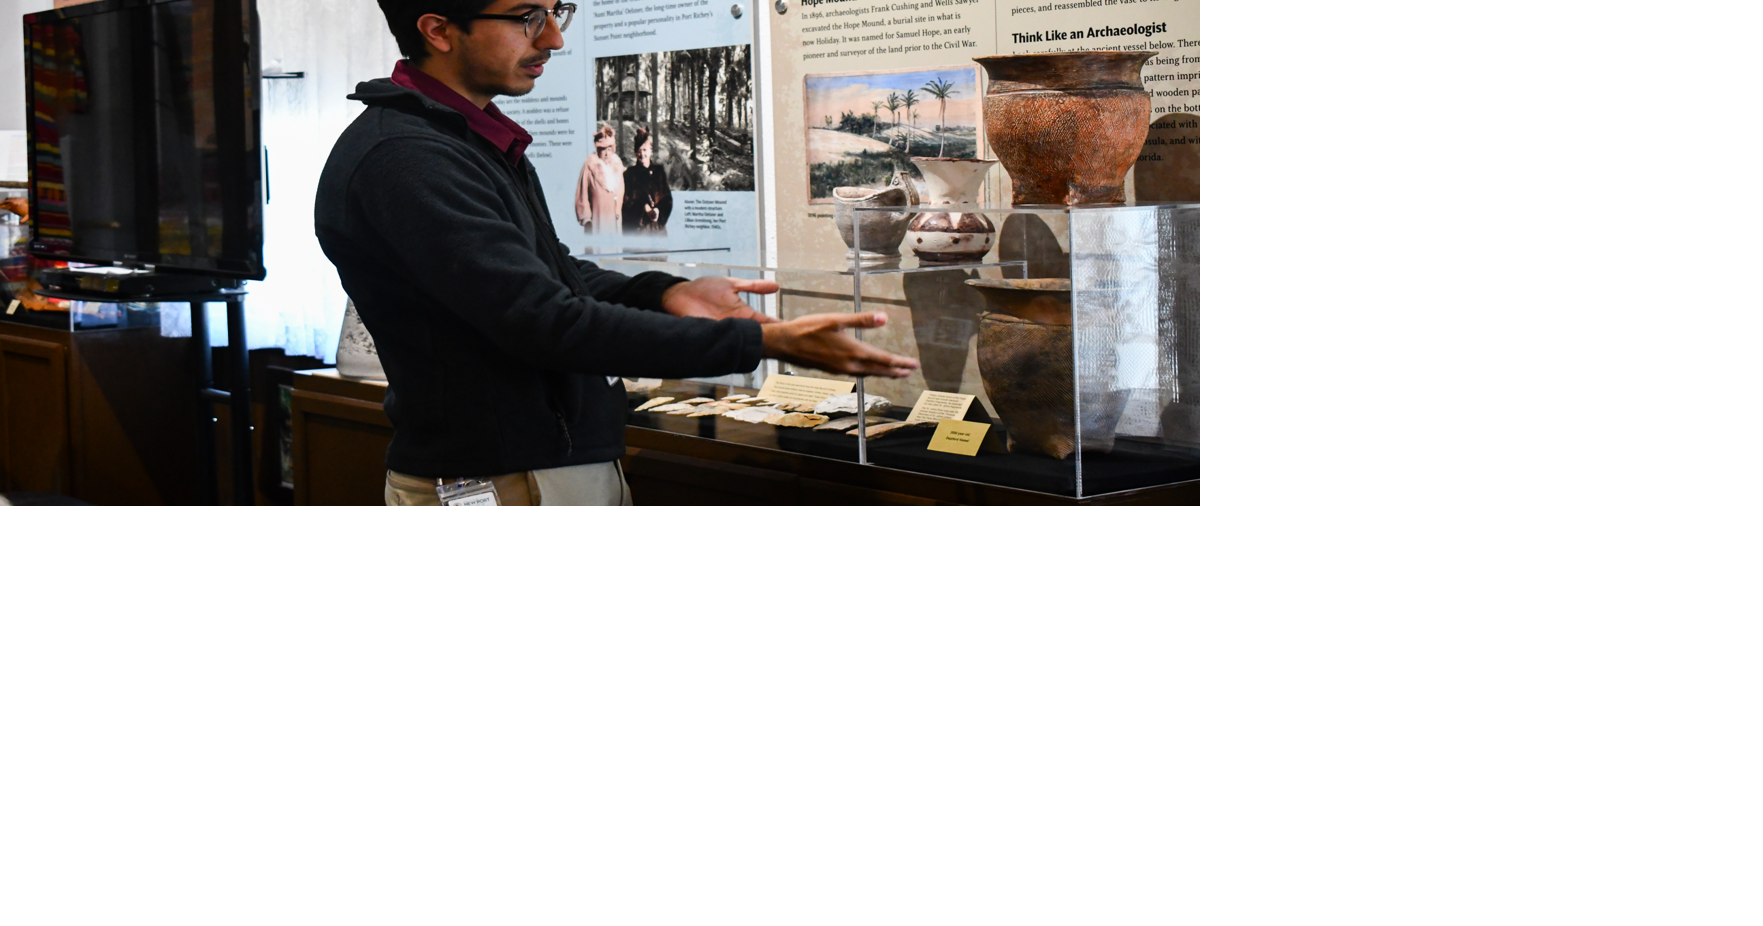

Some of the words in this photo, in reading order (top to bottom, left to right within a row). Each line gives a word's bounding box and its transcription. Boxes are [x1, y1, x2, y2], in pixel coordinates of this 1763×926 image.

[654, 3, 676, 12] long-time
[809, 11, 824, 20] 1896,
[826, 7, 869, 17] archaeologists
[871, 4, 890, 13] Frank
[891, 3, 919, 11] Cushing
[1011, 6, 1036, 16] pieces,
[1038, 3, 1052, 12] and
[1054, 0, 1102, 10] reassembled
[594, 23, 613, 31] property
[628, 19, 647, 28] popular
[648, 15, 674, 25] personality
[802, 24, 830, 33] excavated
[844, 22, 860, 30] Hope
[861, 19, 886, 27] Mound,
[893, 16, 913, 25] burial
[928, 14, 935, 22] in
[936, 13, 953, 21] what
[623, 29, 656, 39] neighborhood.
[816, 36, 840, 45] Holiday.
[861, 32, 883, 41] named
[896, 29, 920, 39] Samuel
[922, 29, 942, 38] Hope,
[954, 25, 971, 35] early
[1012, 31, 1043, 43] Think
[1045, 30, 1067, 41] Like
[1070, 30, 1084, 39] an
[1086, 22, 1167, 38] Archaeologist
[803, 52, 825, 61] pioneer
[840, 49, 867, 57] surveyor
[868, 47, 875, 55] of
[876, 46, 886, 54] the
[888, 45, 903, 53] land
[905, 45, 921, 54] prior
[932, 42, 942, 50] the
[944, 40, 960, 49] Civil
[961, 40, 977, 48] War.
[1123, 41, 1147, 51] vessel
[1149, 40, 1175, 50] below.
[1156, 56, 1180, 66] being
[1144, 73, 1175, 84] pattern
[1156, 88, 1189, 97] wooden
[1168, 104, 1181, 112] the
[1178, 120, 1198, 129] with
[1169, 136, 1186, 145] and
